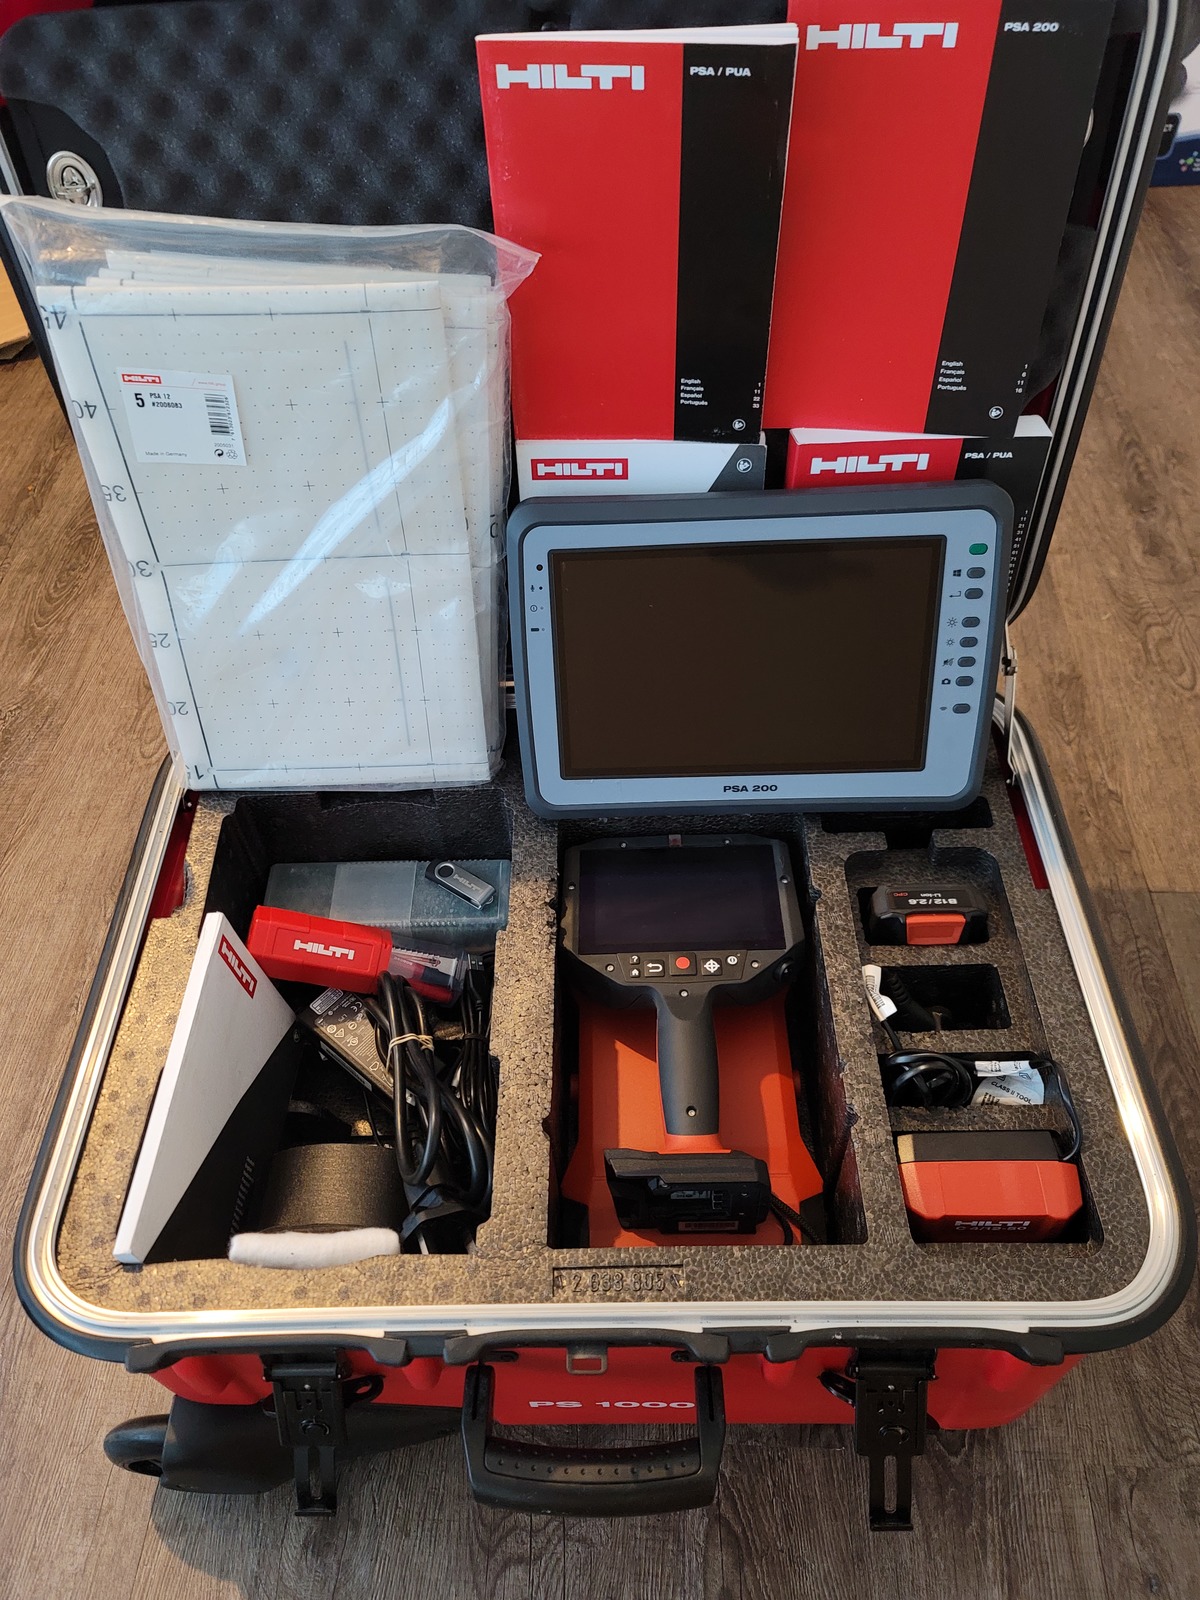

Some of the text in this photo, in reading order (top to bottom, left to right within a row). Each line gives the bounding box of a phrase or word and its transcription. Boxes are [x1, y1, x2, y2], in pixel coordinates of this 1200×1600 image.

[1003, 21, 1059, 32] PSA 200
[805, 22, 959, 50] HILTI
[495, 64, 645, 91] HILTI
[689, 66, 752, 77] PSA / PUA
[134, 392, 145, 407] 5
[149, 392, 161, 400] PSA
[992, 451, 1013, 459] PUA
[536, 462, 623, 476] HILTI
[809, 453, 930, 475] HILTI
[723, 784, 778, 793] PSA 200
[293, 939, 355, 960] HILTI
[221, 941, 255, 992] HILTI
[991, 1081, 1011, 1093] CLASS
[1016, 1092, 1032, 1105] TOOL
[596, 1401, 695, 1409] 1000
